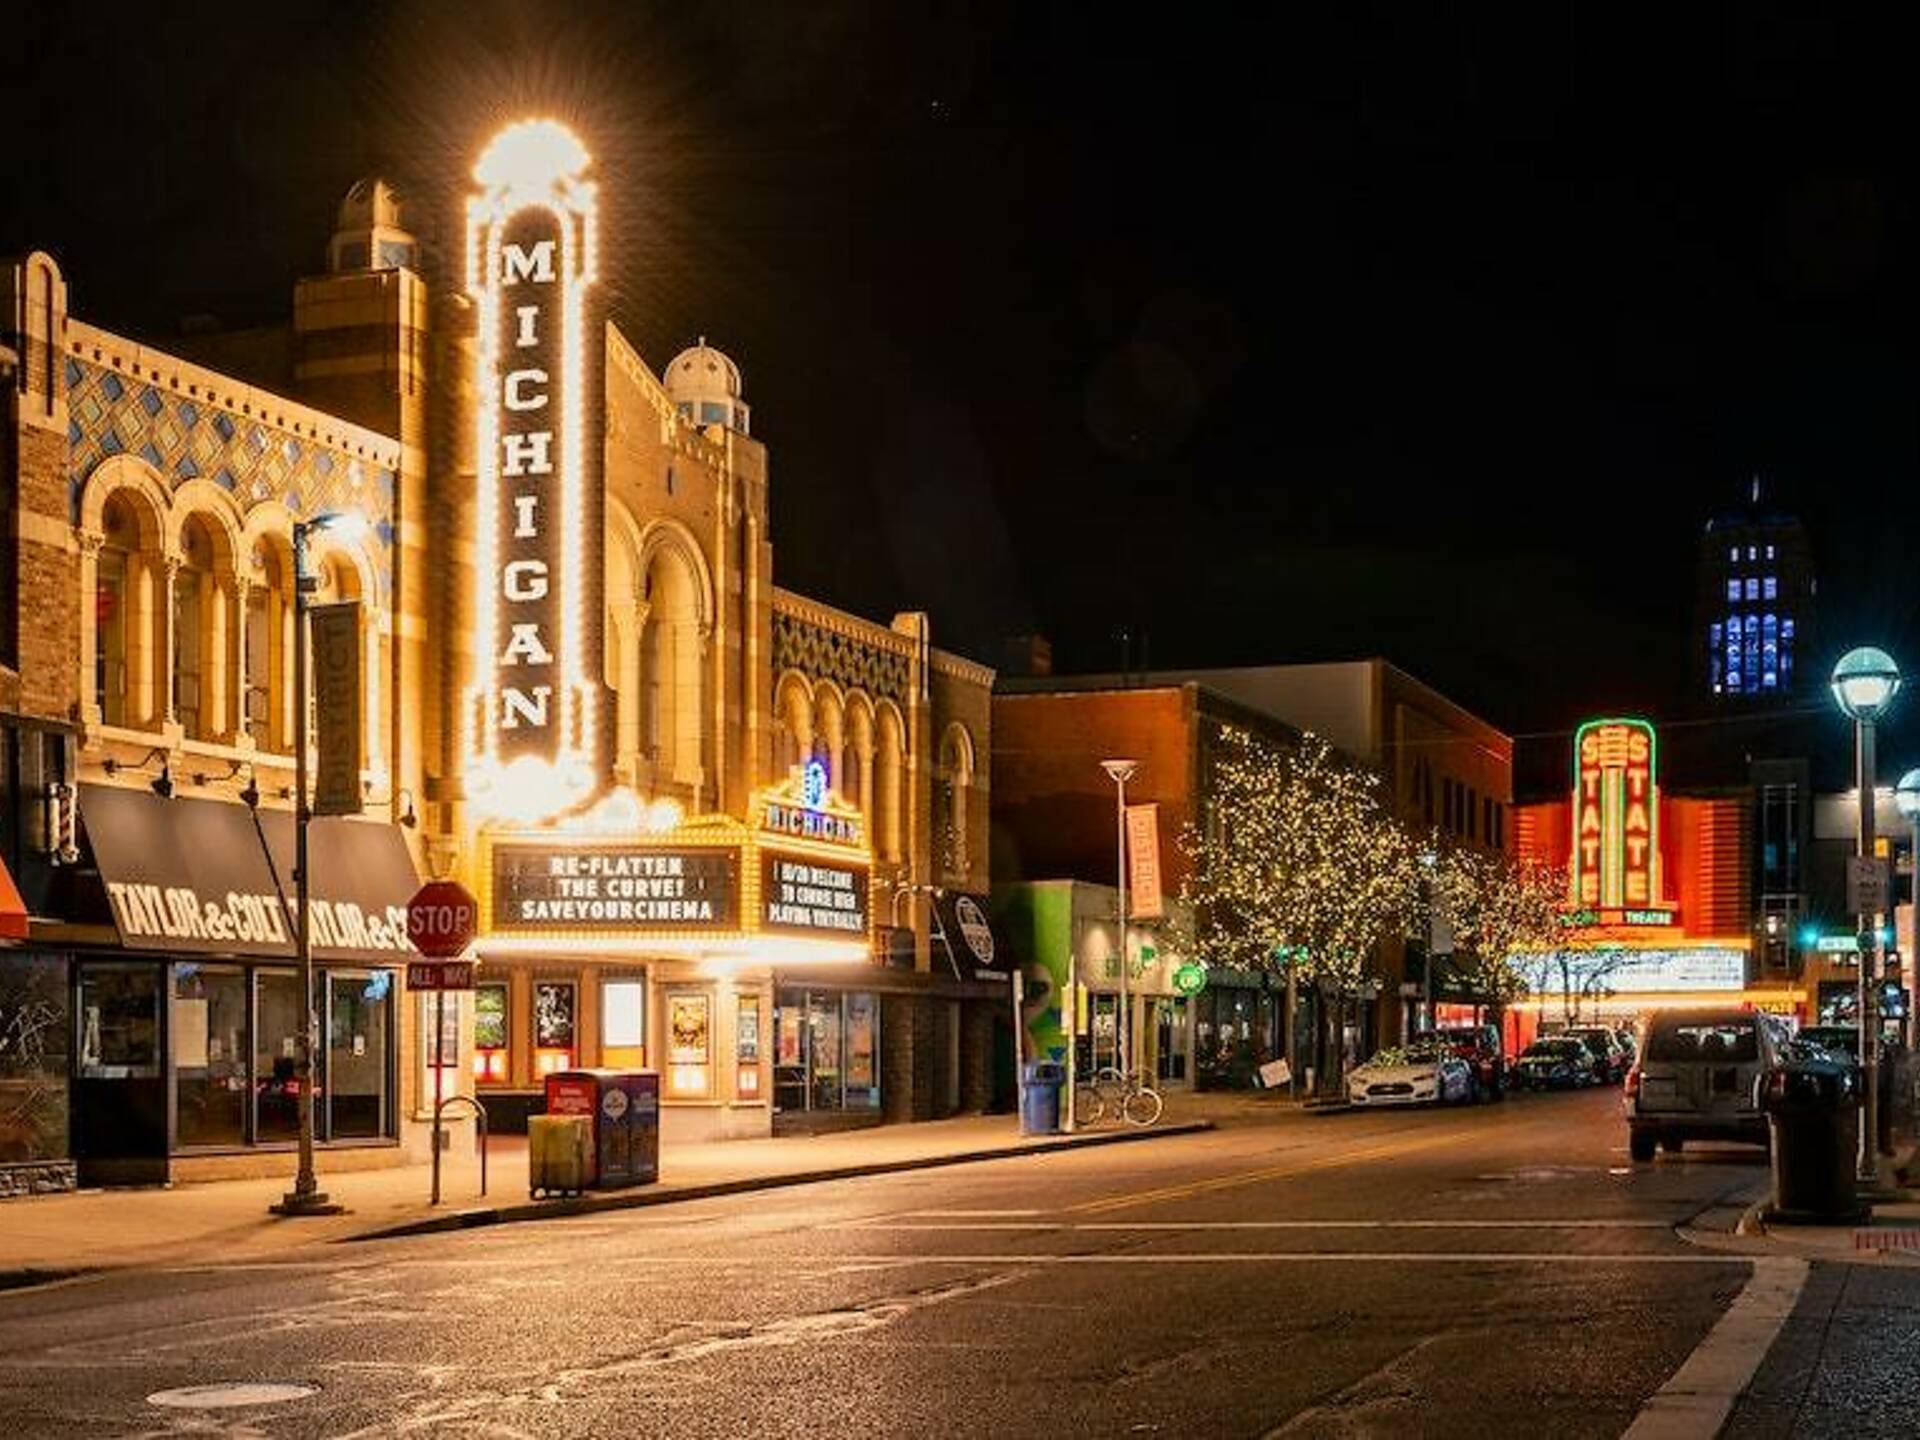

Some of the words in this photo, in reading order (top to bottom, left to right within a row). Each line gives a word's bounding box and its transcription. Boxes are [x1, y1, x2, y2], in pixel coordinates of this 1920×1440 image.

[501, 240, 556, 729] MICHIGAN
[767, 805, 858, 842] MICHIGAN
[1581, 734, 1600, 902] STATE
[1625, 733, 1649, 900] STATE
[550, 856, 684, 876] RE-FLATTEN
[560, 878, 599, 898] THE
[606, 878, 685, 898] CURVE!
[410, 905, 470, 935] STOP
[522, 901, 713, 921] SAVEYOURCINEMA
[409, 966, 435, 986] ALL
